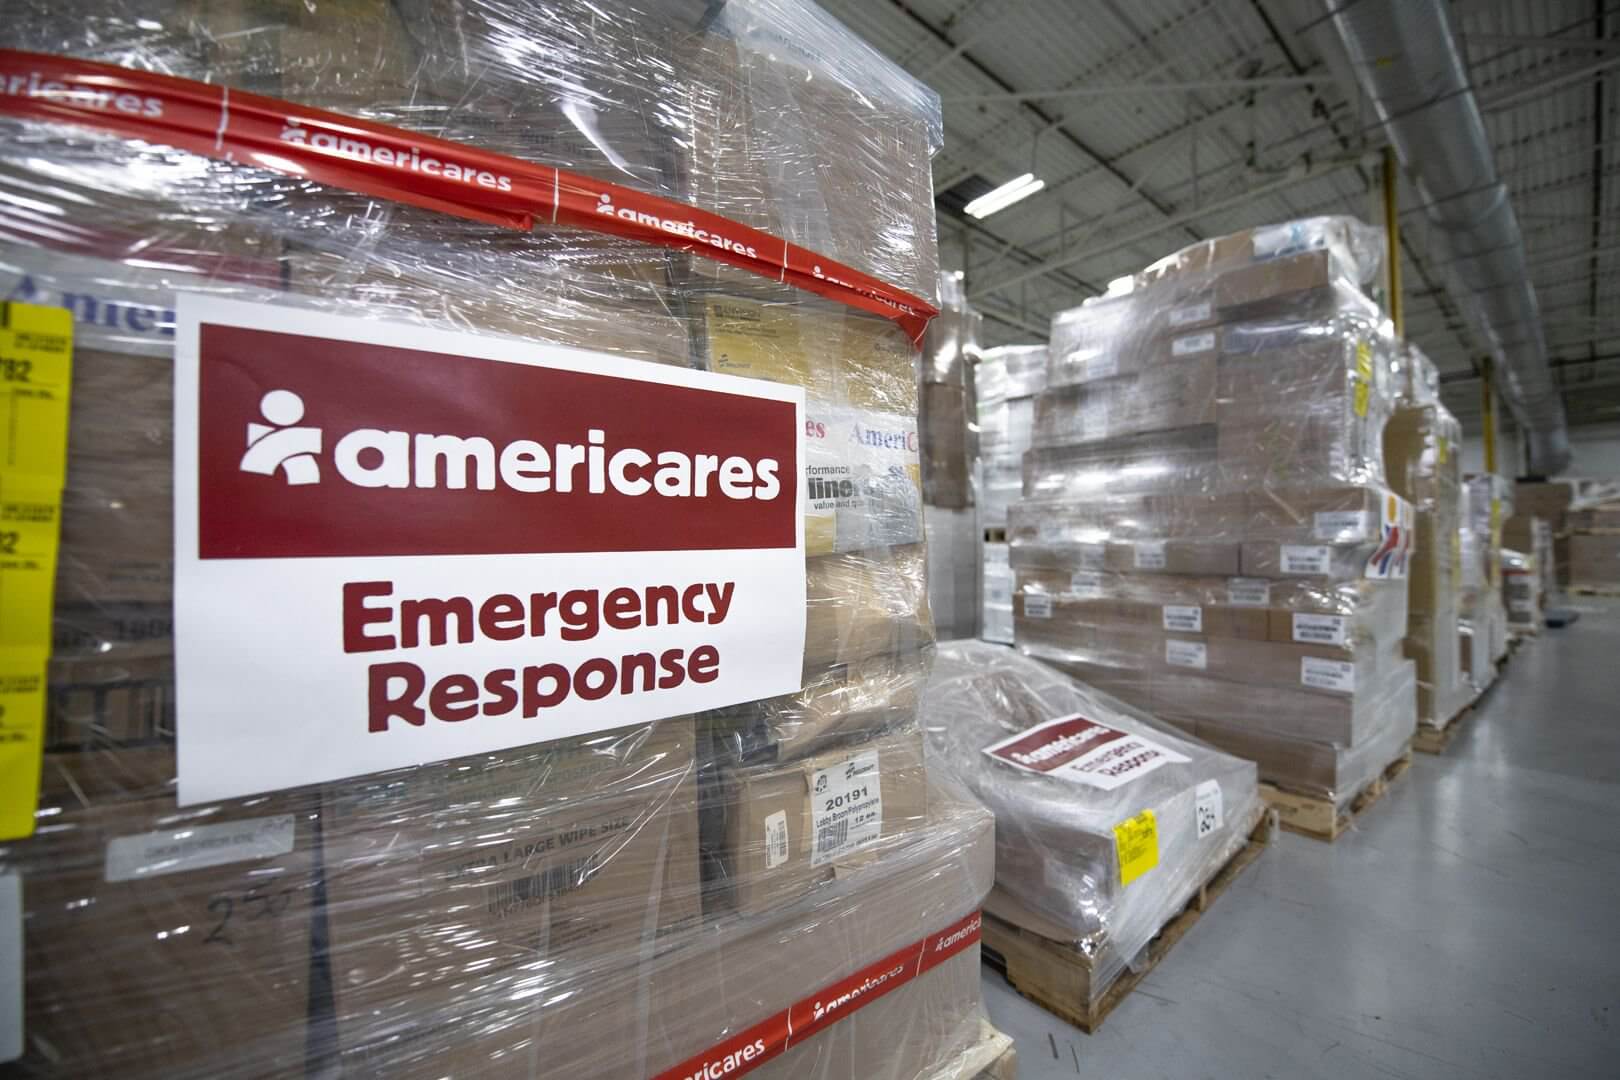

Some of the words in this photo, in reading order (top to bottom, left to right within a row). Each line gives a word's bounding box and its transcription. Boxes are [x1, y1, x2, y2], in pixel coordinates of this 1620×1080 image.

[311, 131, 512, 192] americares
[334, 428, 780, 500] americares
[342, 580, 736, 654] Emergency
[367, 644, 721, 733] Response
[825, 786, 868, 812] 20191
[503, 837, 555, 863] LARGE
[559, 825, 597, 848] WIPE
